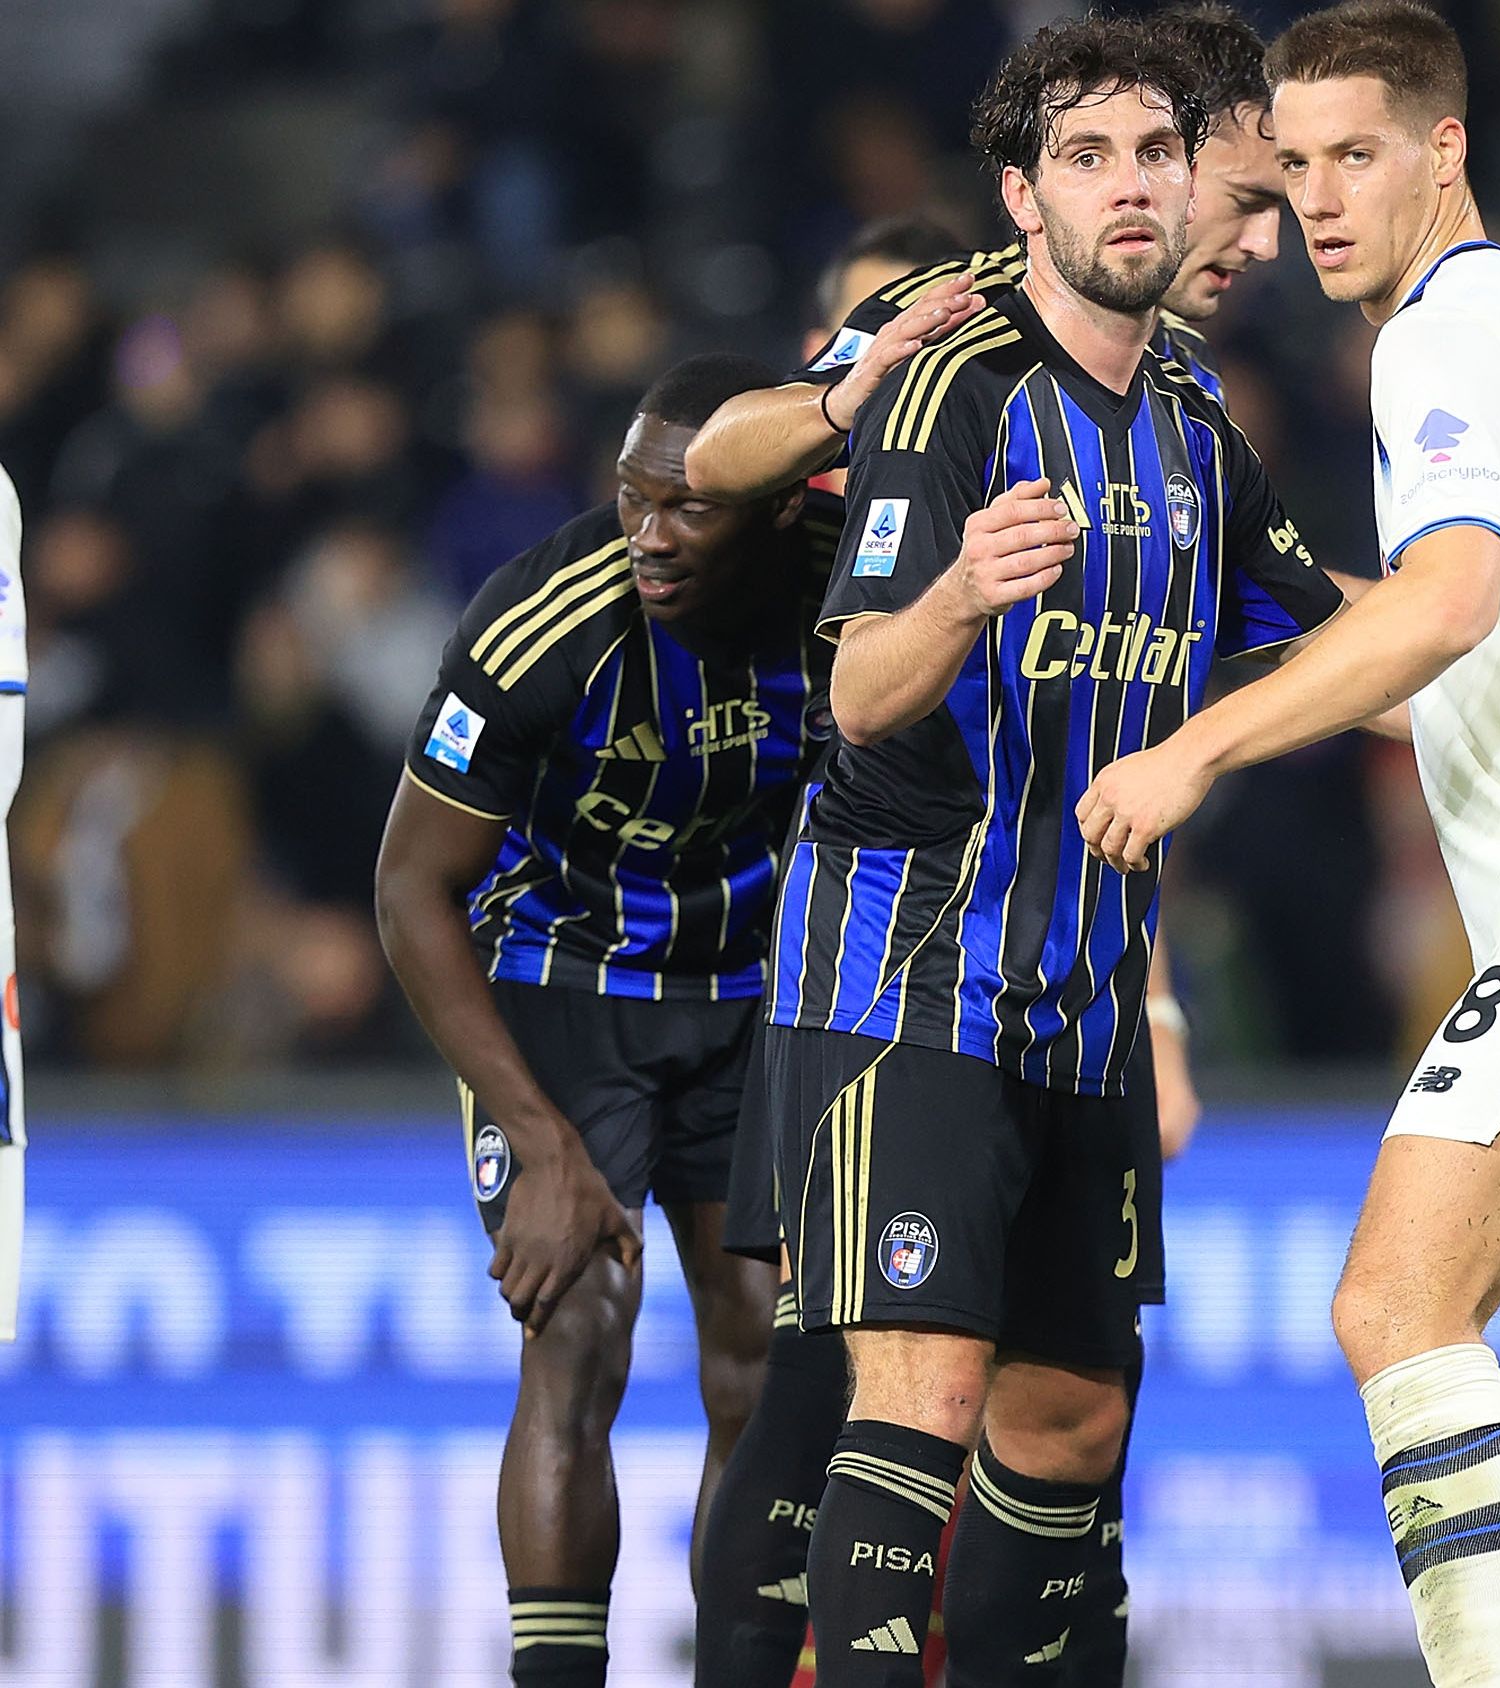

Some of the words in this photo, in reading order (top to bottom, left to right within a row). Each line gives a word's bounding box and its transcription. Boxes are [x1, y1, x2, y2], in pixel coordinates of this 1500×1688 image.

[1097, 482, 1151, 523] HTS
[1168, 484, 1194, 501] PISA
[866, 541, 886, 549] SERIE
[1021, 610, 1202, 687] Cetilar
[685, 699, 771, 745] HTS
[889, 1221, 932, 1241] PISA
[1114, 1168, 1138, 1279] 3
[768, 1499, 818, 1532] PIS
[850, 1540, 935, 1577] PISA
[1040, 1571, 1085, 1599] PIS
